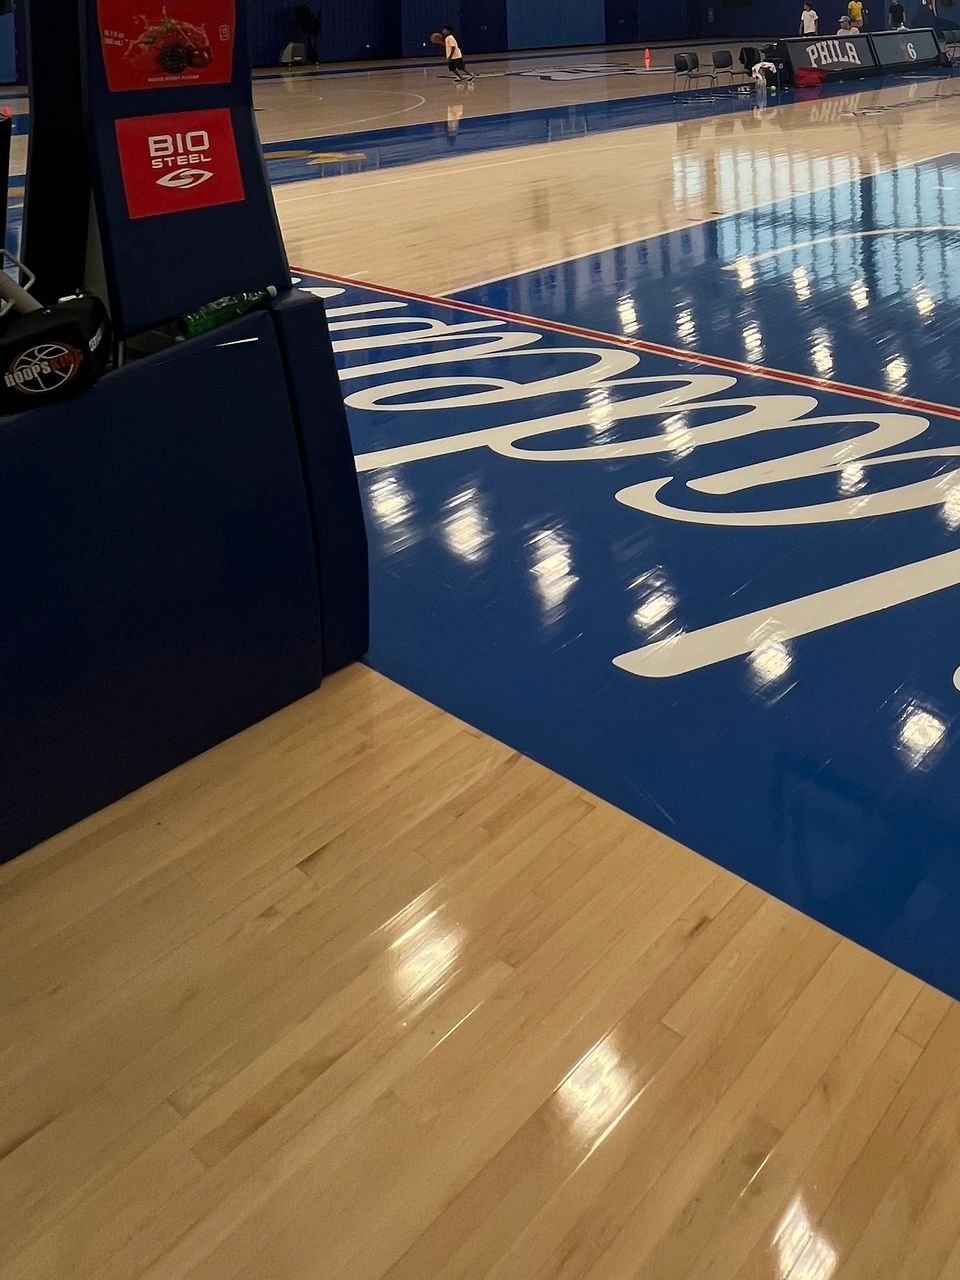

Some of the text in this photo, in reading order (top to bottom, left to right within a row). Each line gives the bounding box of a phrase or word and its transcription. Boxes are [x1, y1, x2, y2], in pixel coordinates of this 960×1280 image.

[806, 40, 861, 68] PHILA
[148, 130, 210, 157] BIO
[152, 154, 212, 168] STEEL
